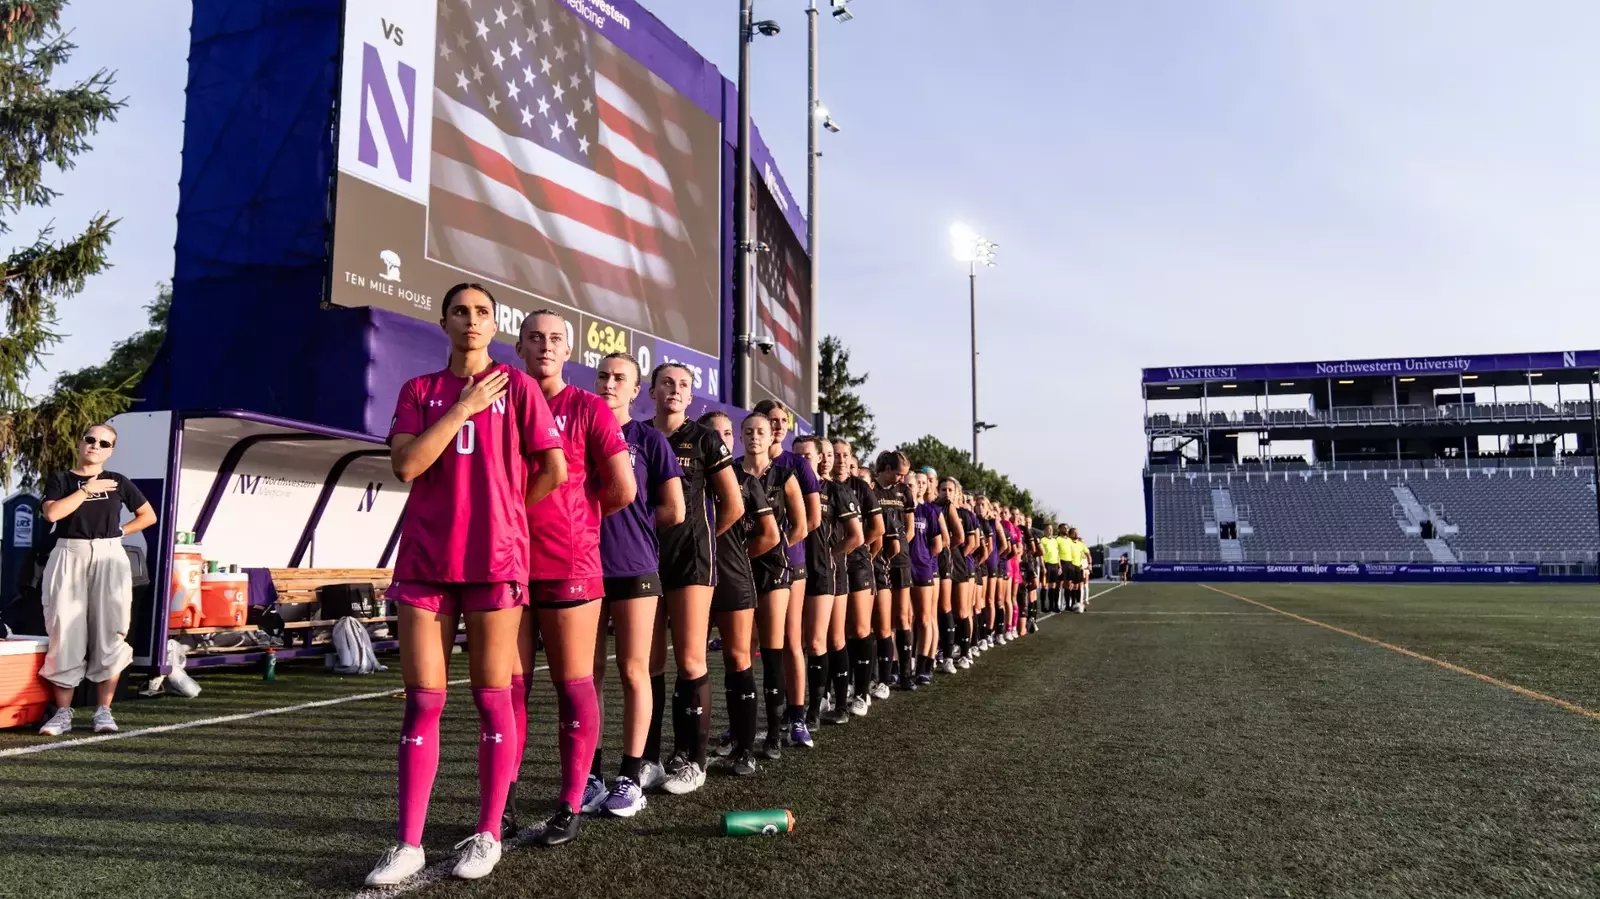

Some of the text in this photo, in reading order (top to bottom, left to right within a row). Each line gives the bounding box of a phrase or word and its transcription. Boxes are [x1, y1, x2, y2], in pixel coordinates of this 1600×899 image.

[566, 0, 604, 28] edicine
[381, 18, 404, 46] VS
[358, 41, 416, 183] N
[345, 271, 365, 287] TEN
[370, 280, 394, 296] MILE
[398, 288, 432, 307] HOUSE
[587, 321, 627, 354] 6:34
[583, 350, 602, 370] 1ST
[637, 346, 651, 377] 0
[708, 367, 719, 397] N
[1315, 358, 1471, 375] Northwestern University
[1563, 351, 1576, 368] N
[456, 419, 475, 455] 0
[262, 475, 316, 489] Northwestern
[357, 481, 383, 513] N
[1266, 565, 1298, 573] SEATGEEK
[1301, 564, 1329, 574] meijer
